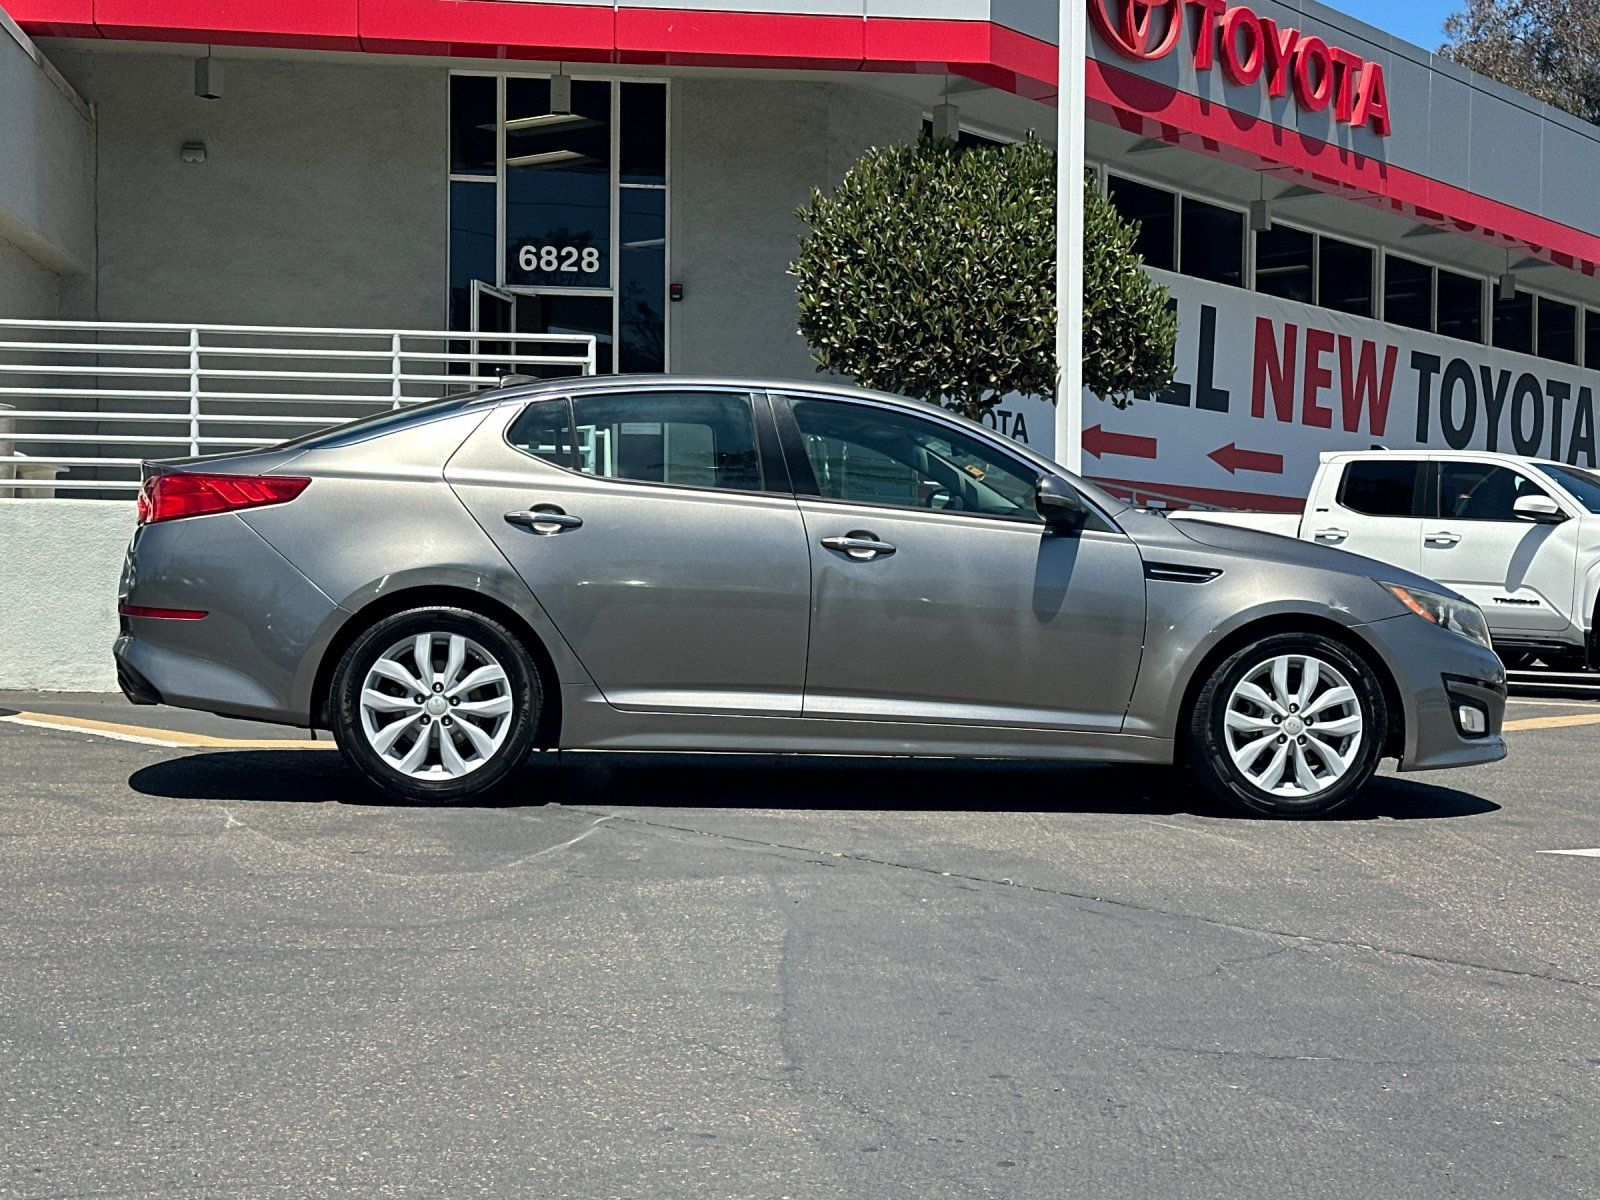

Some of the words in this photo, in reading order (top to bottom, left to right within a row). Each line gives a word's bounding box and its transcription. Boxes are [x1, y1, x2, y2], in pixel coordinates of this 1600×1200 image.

[1185, 0, 1391, 136] TOYOTA
[519, 245, 600, 273] 6828
[1134, 298, 1229, 413] LL
[1251, 316, 1399, 437] NEW
[1411, 350, 1597, 468] TOYOTA
